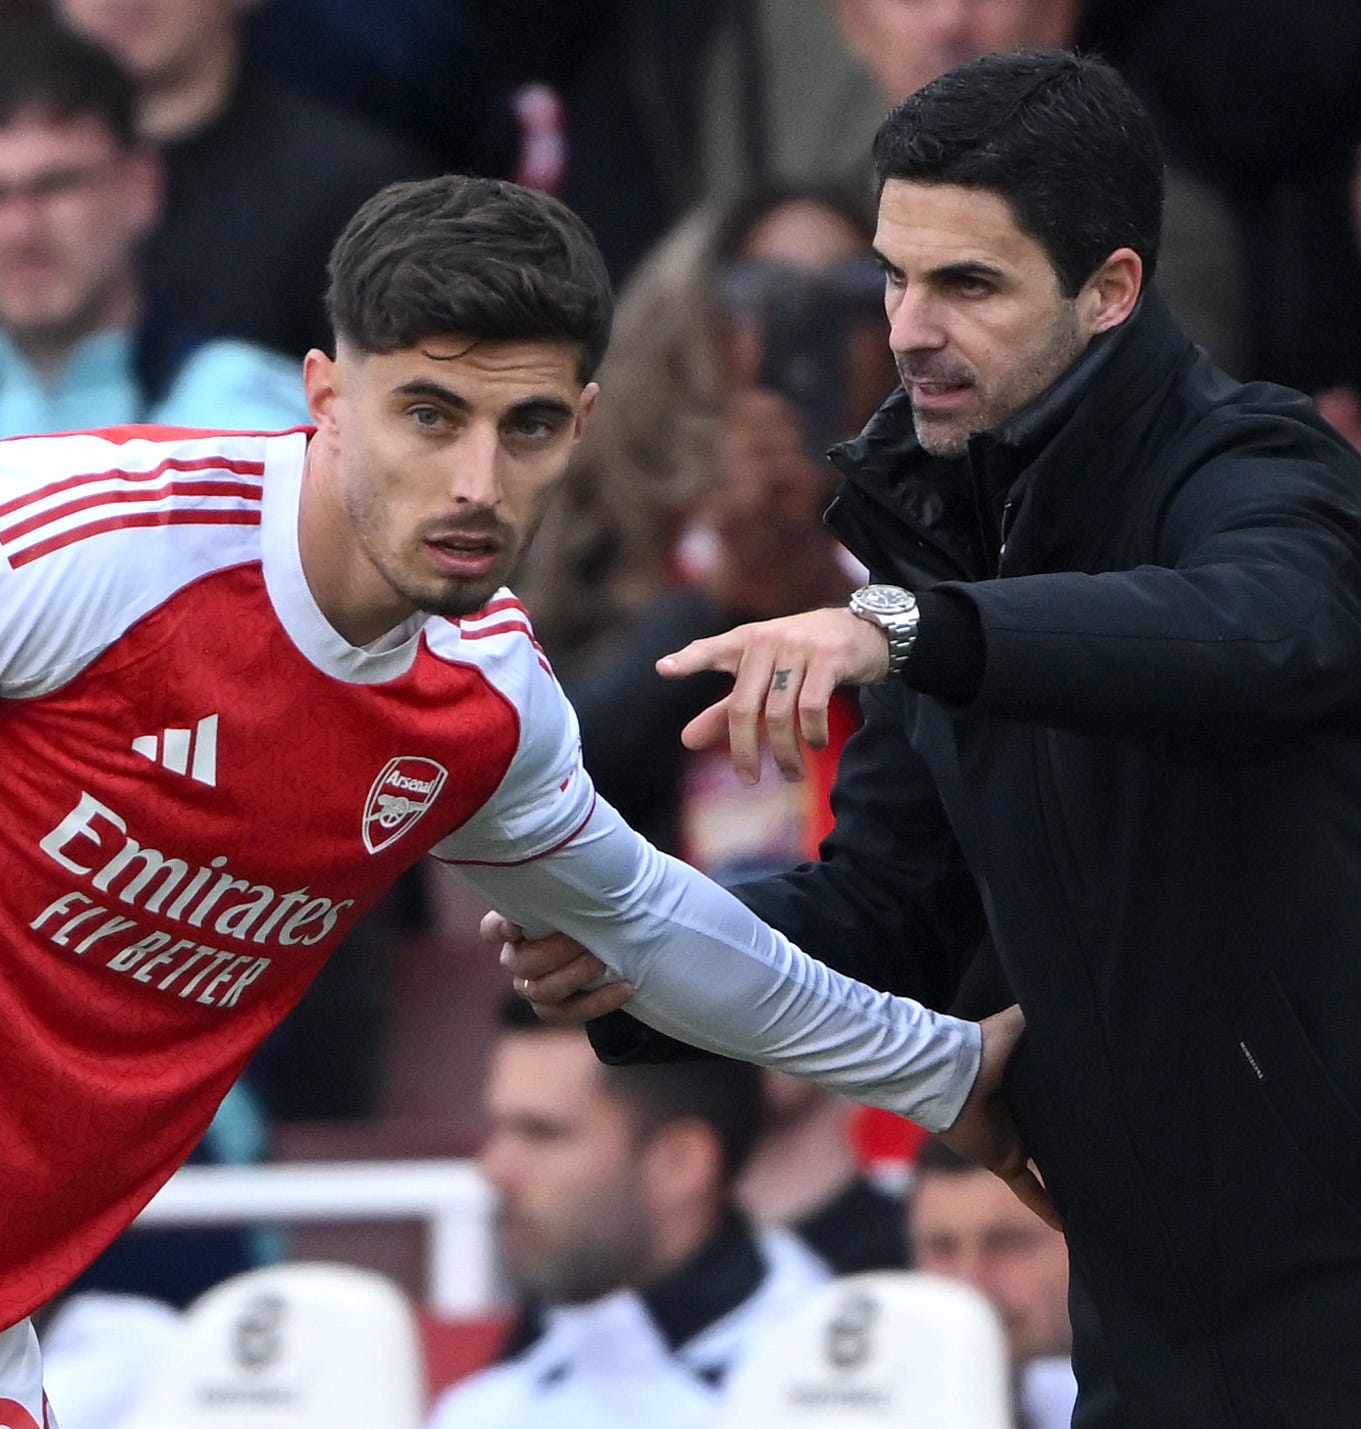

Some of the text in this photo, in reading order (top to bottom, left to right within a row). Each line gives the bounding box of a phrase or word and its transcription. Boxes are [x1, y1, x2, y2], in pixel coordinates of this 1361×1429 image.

[386, 770, 436, 793] Arsenal
[39, 790, 354, 946] Emirates
[30, 891, 272, 1008] FLY BETTER
